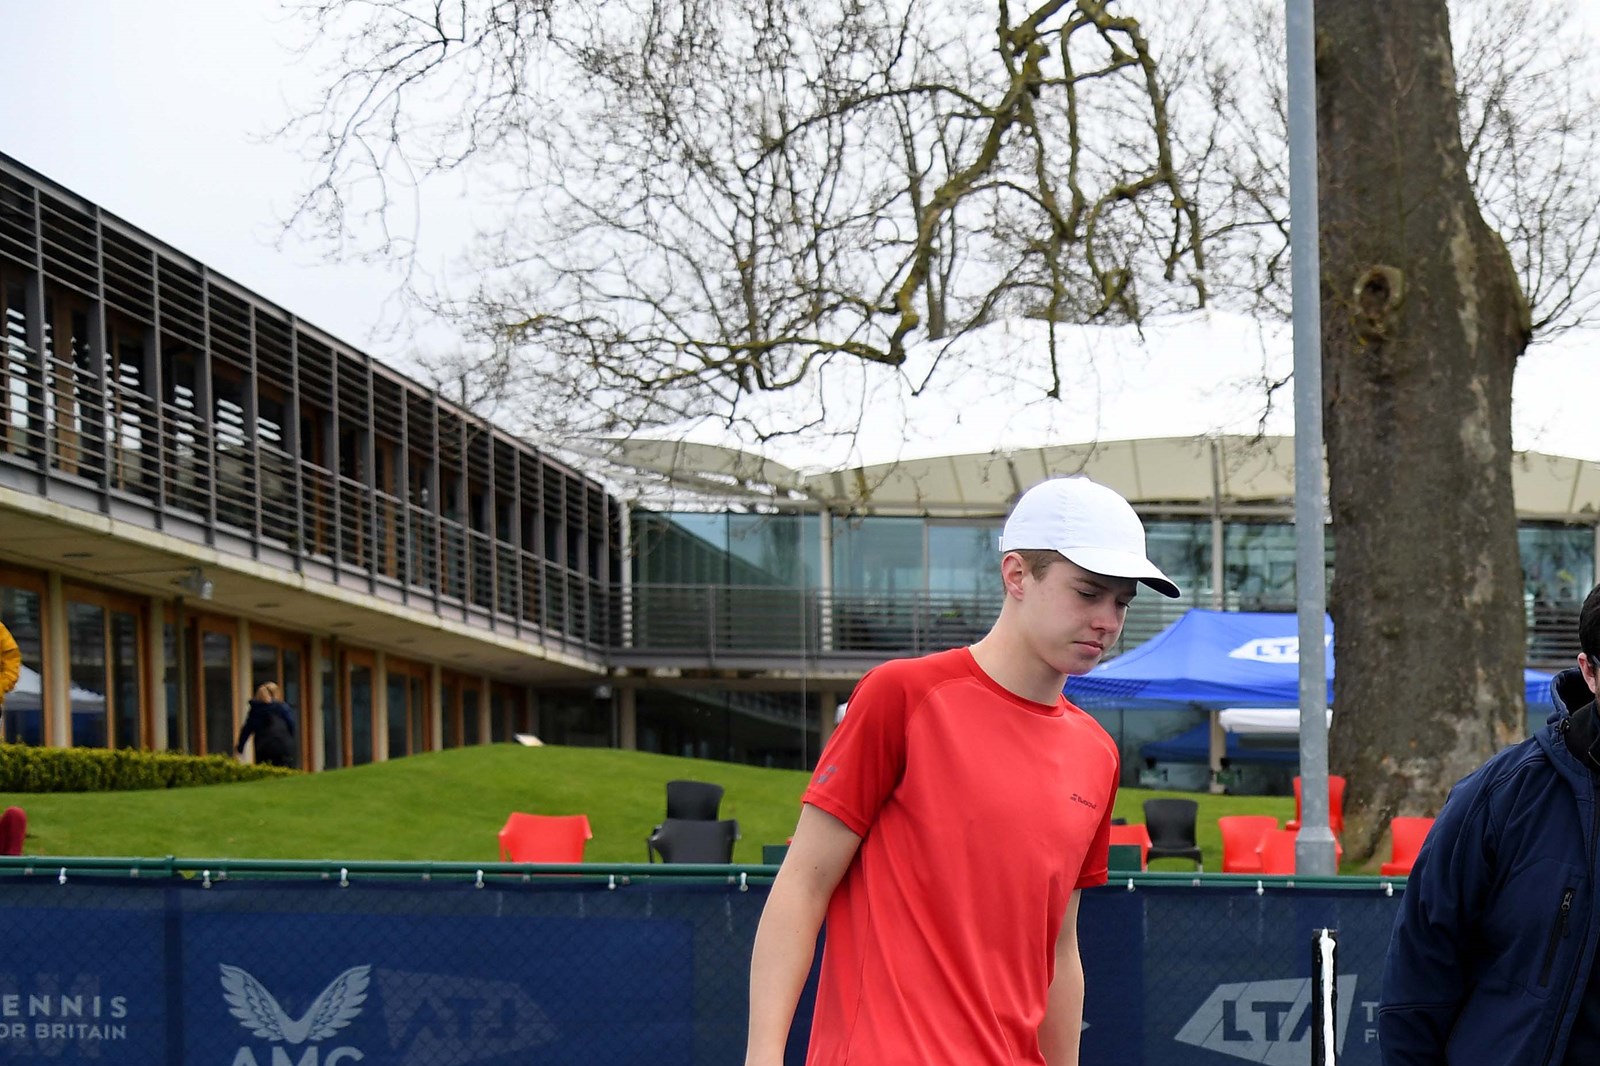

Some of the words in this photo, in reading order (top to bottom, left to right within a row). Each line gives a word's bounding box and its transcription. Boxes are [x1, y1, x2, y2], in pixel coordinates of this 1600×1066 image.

[2, 994, 127, 1018] ENNIS
[0, 1023, 27, 1039] OR
[34, 1023, 127, 1040] BRITAIN
